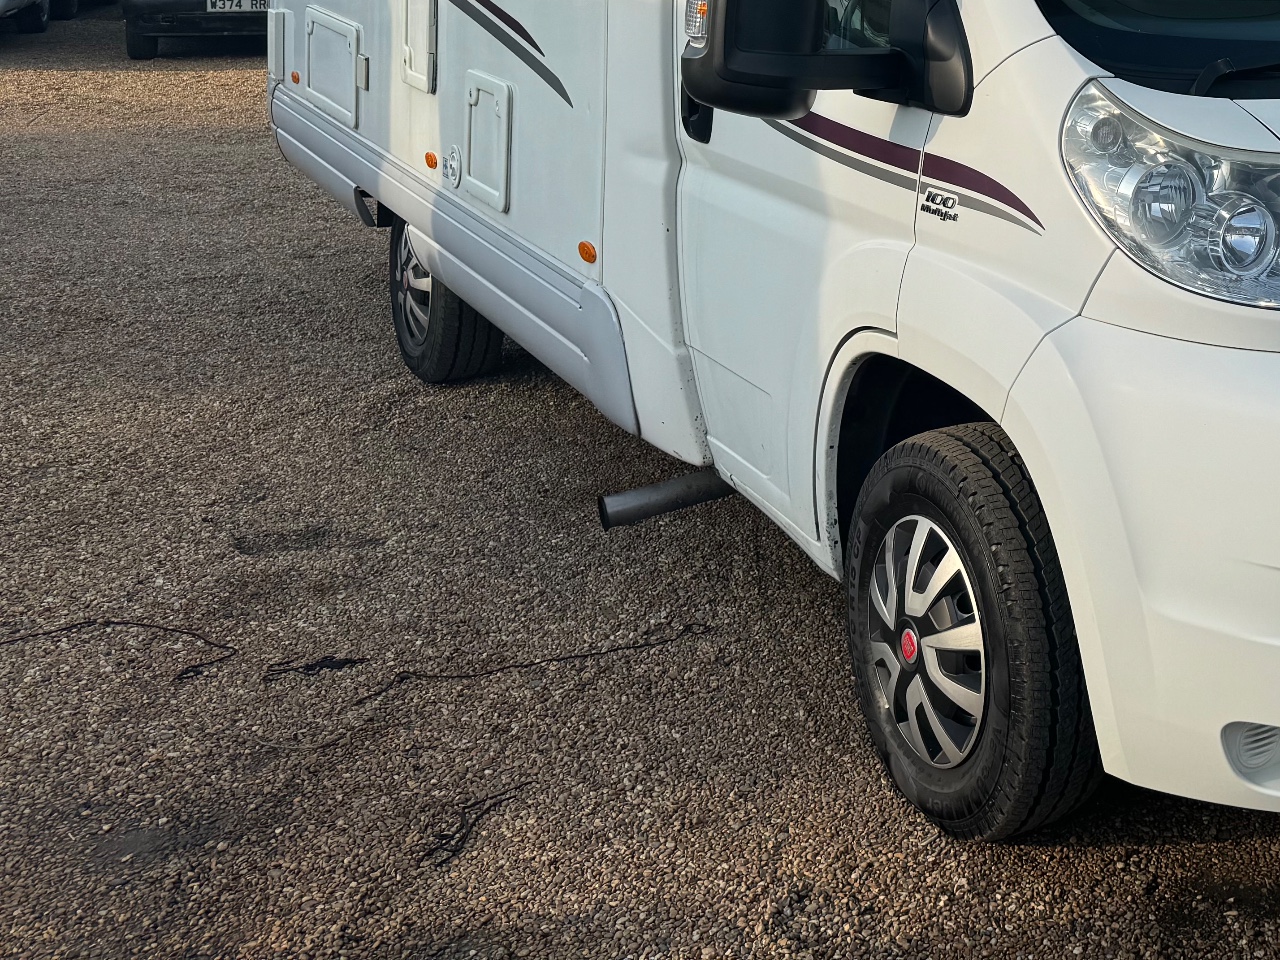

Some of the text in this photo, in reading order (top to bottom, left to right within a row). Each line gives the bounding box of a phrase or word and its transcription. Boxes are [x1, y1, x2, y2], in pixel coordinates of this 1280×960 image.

[210, 0, 269, 10] W374 RR
[925, 190, 957, 209] 100
